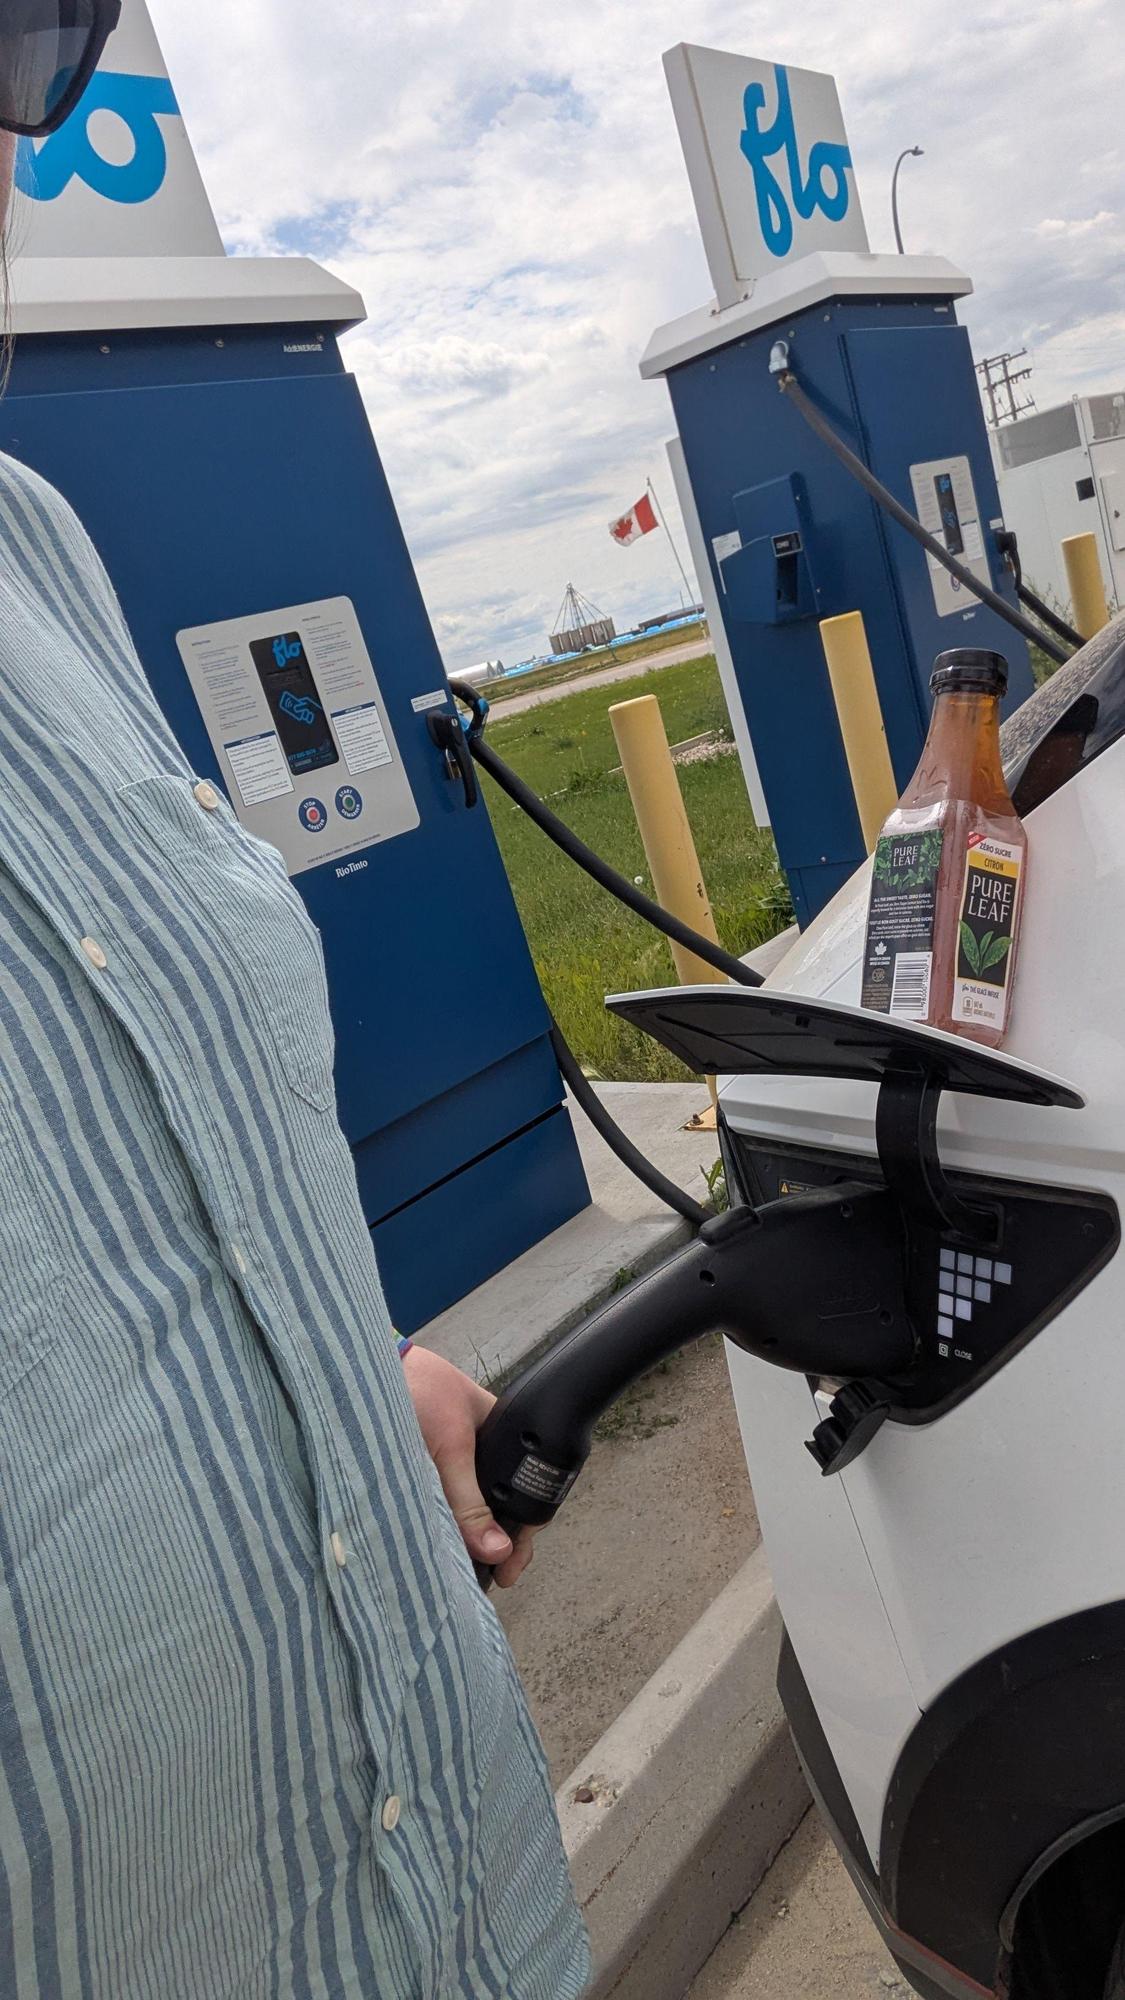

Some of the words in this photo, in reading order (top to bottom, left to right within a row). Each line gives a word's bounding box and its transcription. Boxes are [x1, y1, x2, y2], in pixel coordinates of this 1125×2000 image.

[739, 64, 853, 257] flo
[272, 635, 302, 668] flo
[339, 788, 353, 798] START
[303, 801, 316, 810] STOP
[893, 844, 919, 858] PURE
[892, 855, 917, 867] LEAF
[984, 858, 1004, 872] CITRON
[971, 874, 1013, 904] PURE
[967, 895, 1010, 923] LEAF
[954, 1349, 972, 1361] CLOSE
